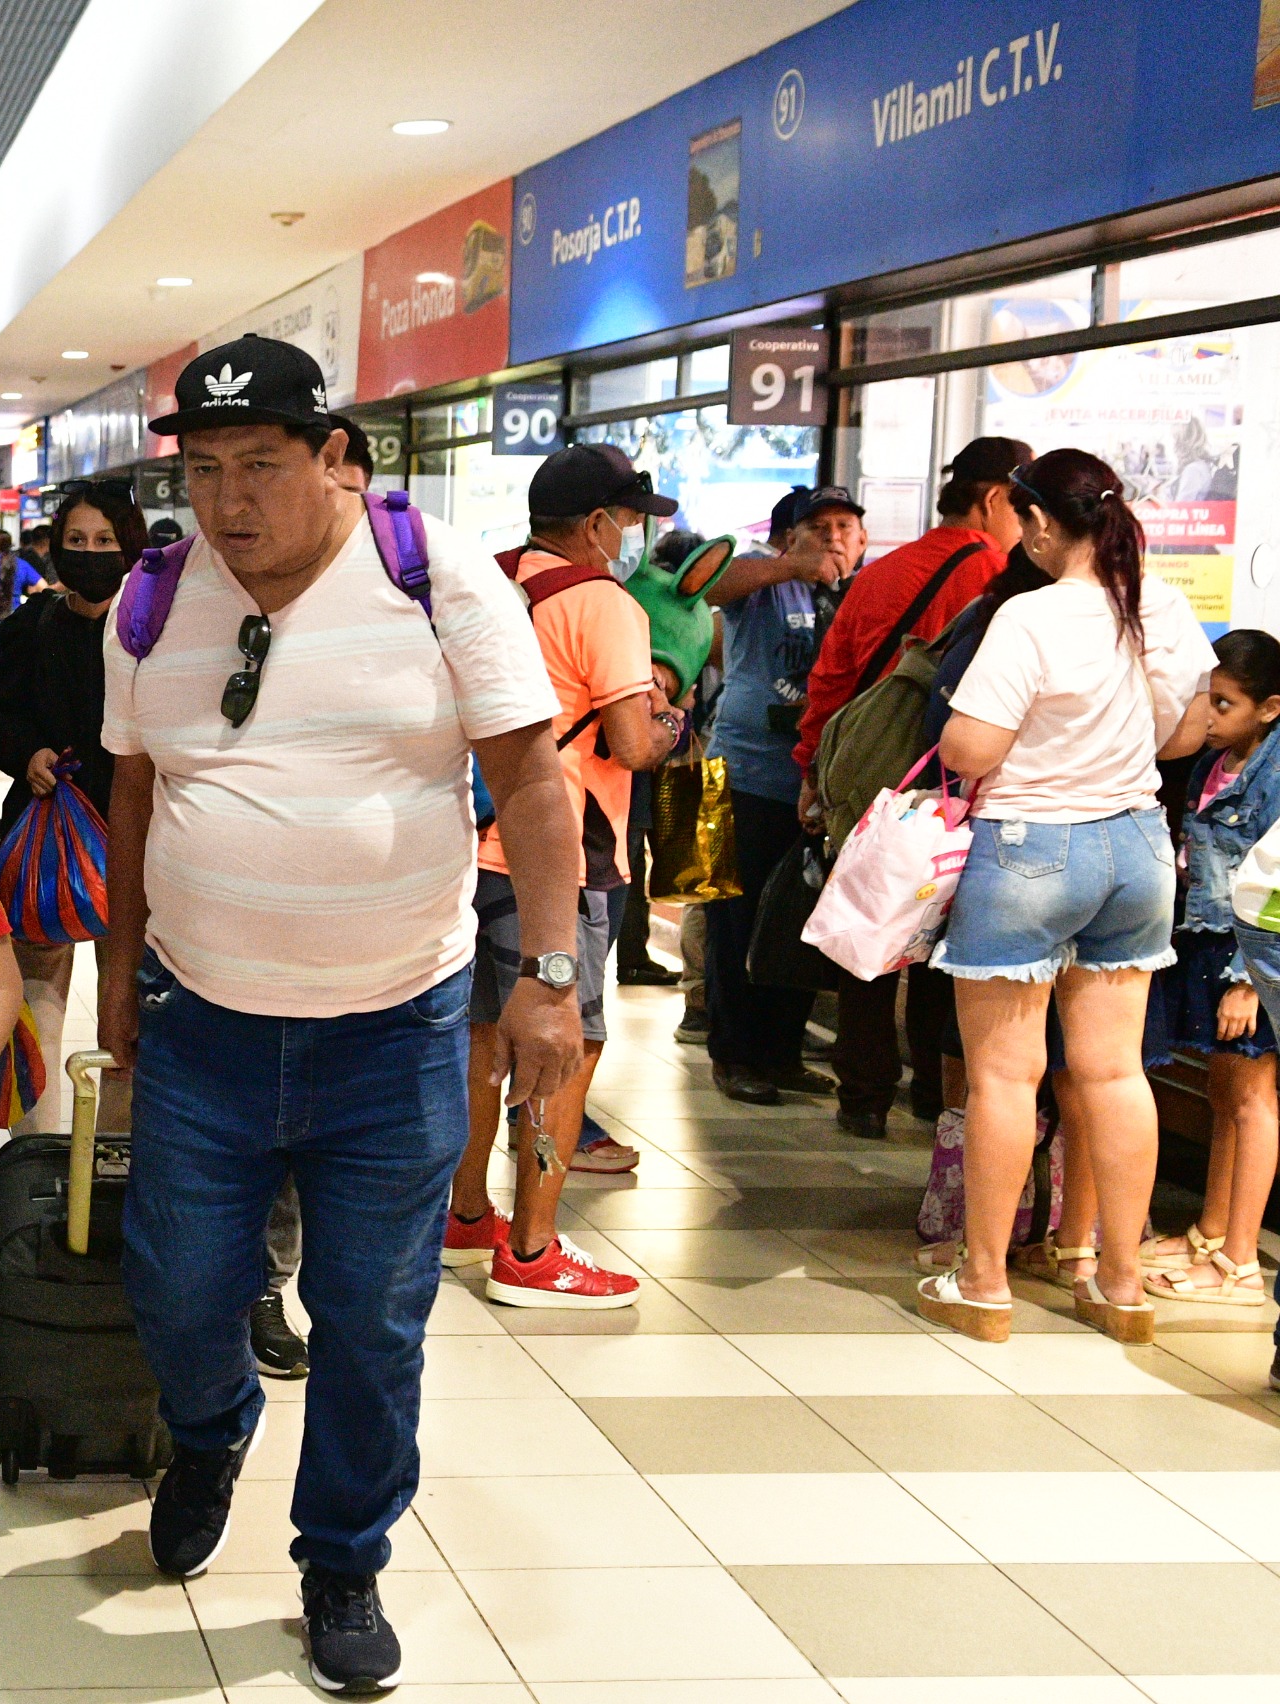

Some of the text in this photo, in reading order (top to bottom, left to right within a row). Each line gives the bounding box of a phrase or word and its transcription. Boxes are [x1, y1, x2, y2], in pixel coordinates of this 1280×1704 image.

[872, 21, 1063, 148] Villamil C.T.V.
[779, 84, 796, 125] 91
[552, 196, 642, 266] Posorja C.T.P.
[380, 277, 456, 340] Poza Honda
[749, 339, 819, 352] Cooperativa
[505, 391, 558, 402] Cooperativa
[751, 363, 816, 412] 91
[201, 397, 250, 408] adidas
[1097, 408, 1146, 421] HACER
[1151, 407, 1190, 421] FILA!
[502, 408, 557, 446] 90
[1192, 508, 1210, 520] TU
[1168, 524, 1186, 536] EN
[1188, 521, 1227, 536] LÍNEA
